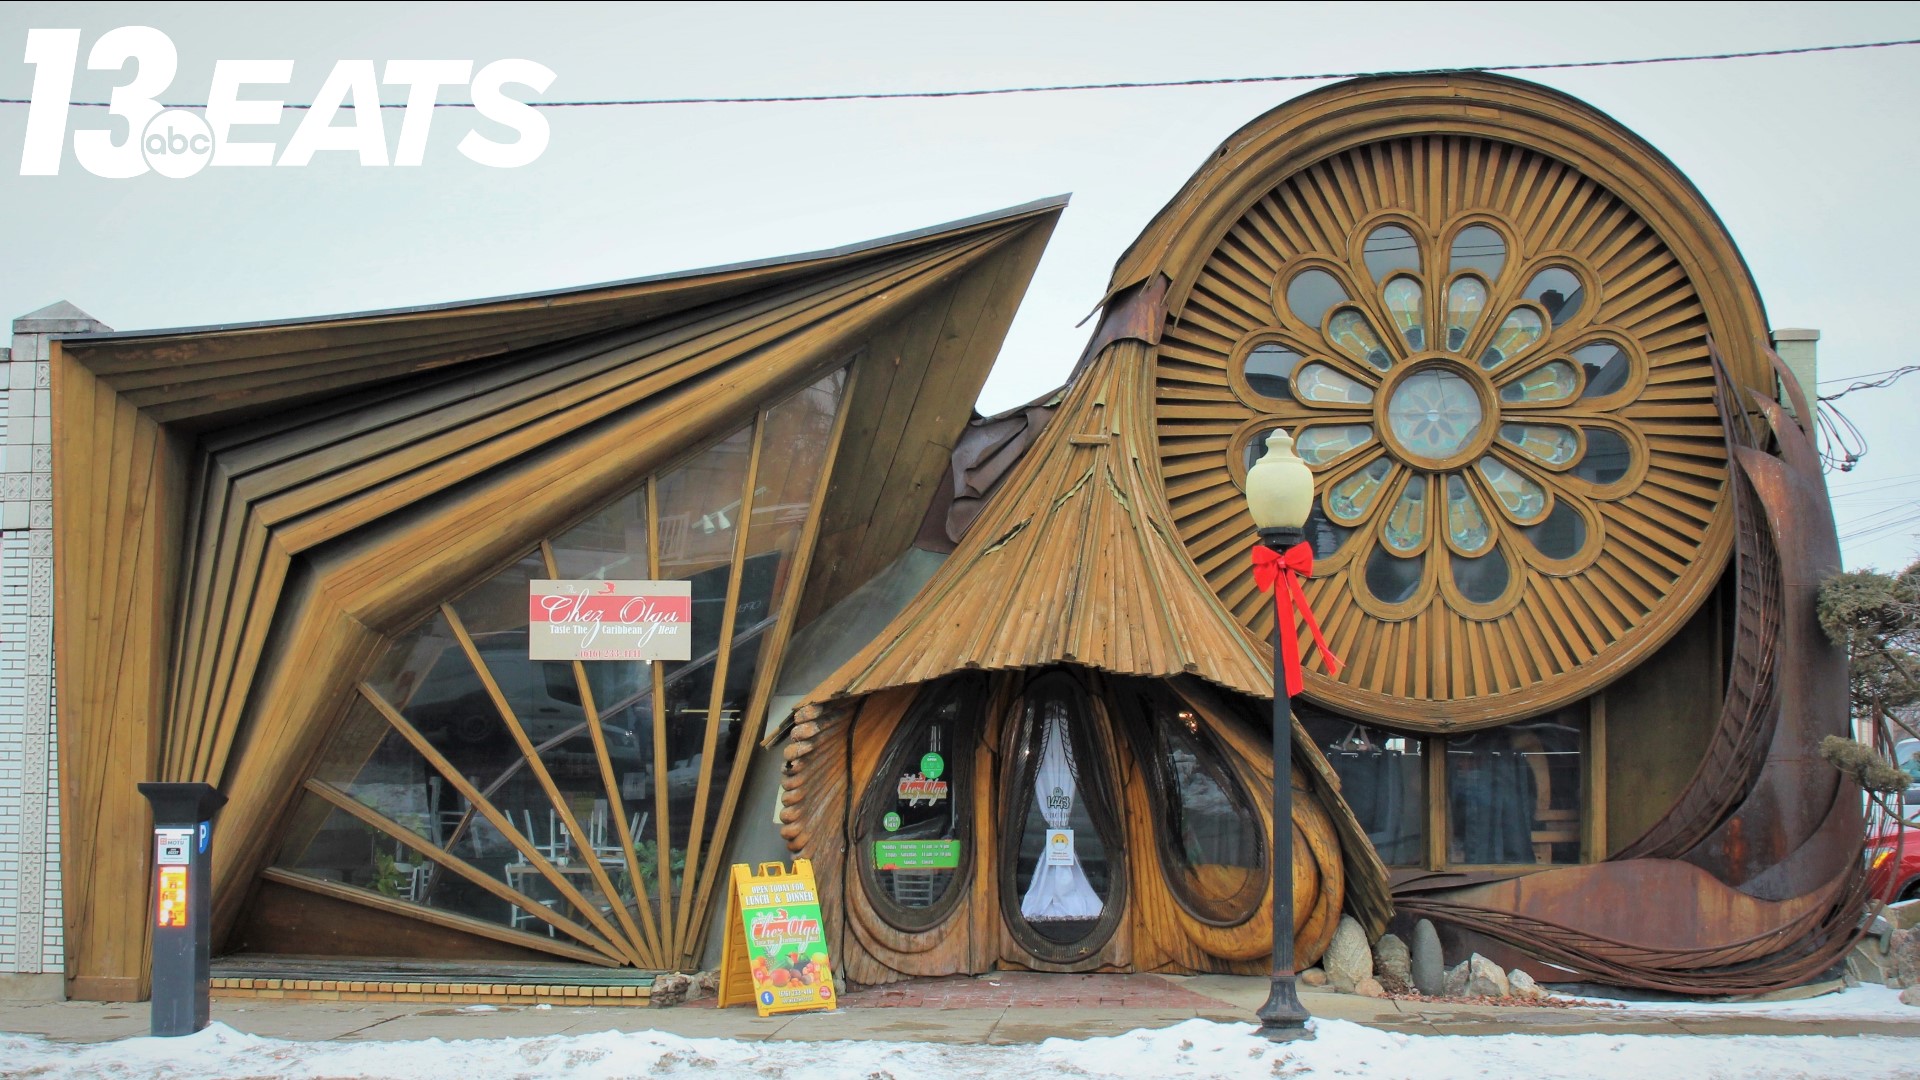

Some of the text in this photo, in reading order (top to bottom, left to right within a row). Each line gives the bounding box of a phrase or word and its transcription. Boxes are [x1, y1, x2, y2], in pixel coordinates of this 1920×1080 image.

[541, 588, 679, 648] Chez Olga
[550, 624, 678, 634] Taste The Caribbean Heat
[1046, 796, 1070, 810] 1443
[200, 824, 206, 848] P
[752, 883, 804, 894] OPEN TODAY FOR
[746, 892, 814, 906] LUNCH & DINNER
[751, 912, 820, 956] Chez Olga
